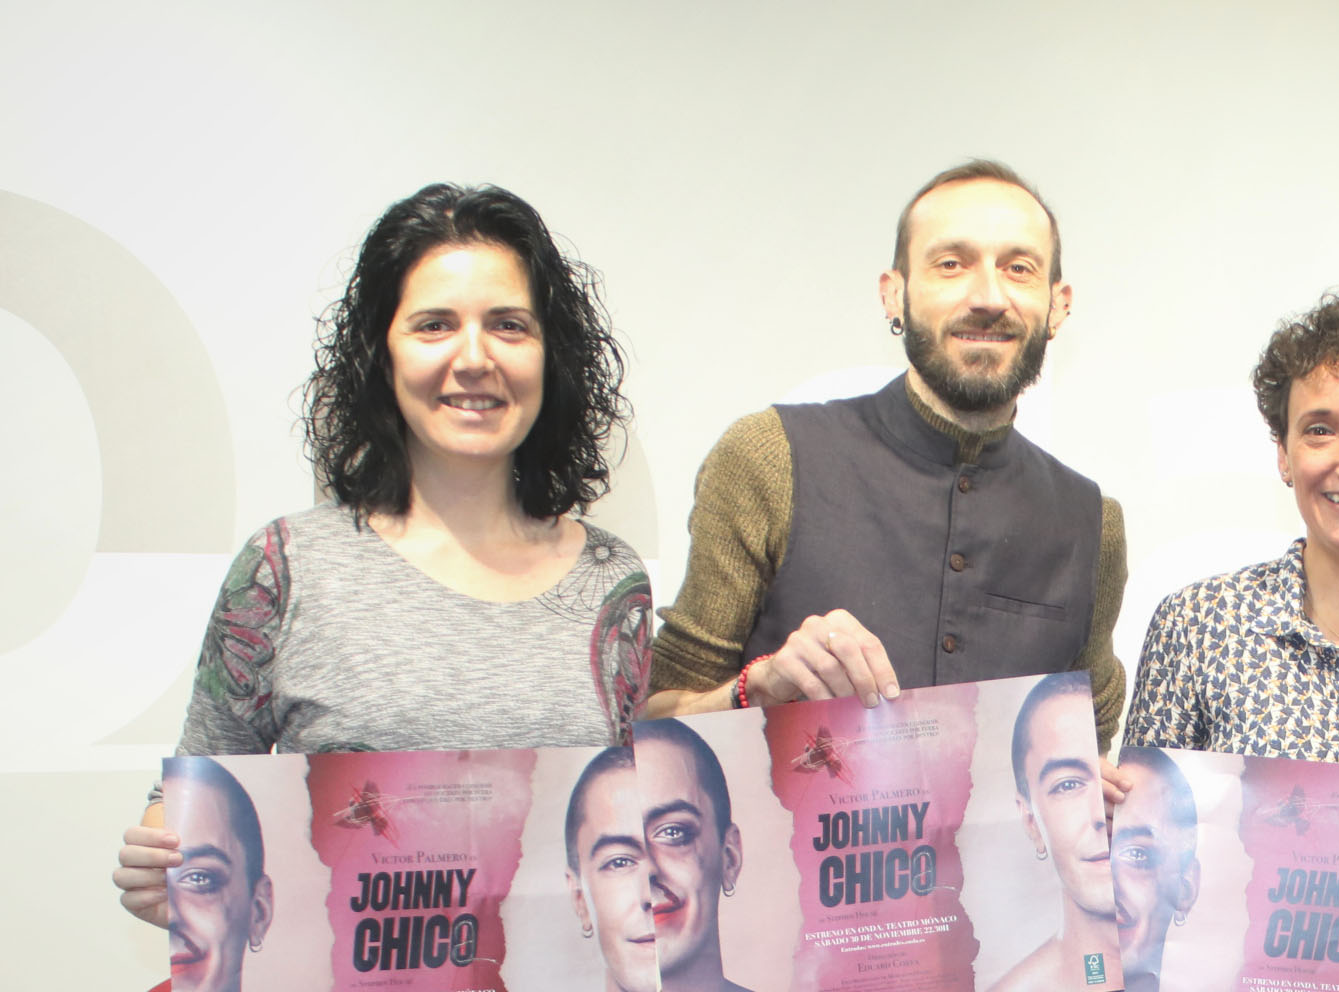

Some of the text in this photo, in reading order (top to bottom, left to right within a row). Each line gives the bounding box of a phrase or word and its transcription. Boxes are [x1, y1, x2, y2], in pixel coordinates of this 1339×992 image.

[871, 787, 920, 800] PALMERO
[813, 801, 930, 852] JOHNNY
[416, 850, 468, 862] PALMERO
[819, 844, 936, 908] CHICO
[350, 868, 477, 913] JOHNNY
[804, 928, 844, 941] ESTRENO
[844, 926, 856, 935] EN
[884, 918, 919, 930] TEATRO
[920, 914, 958, 925] MÓNACO
[859, 933, 873, 941] DE
[873, 926, 923, 940] NOVIEMBRE
[352, 912, 479, 972] CHICO
[1242, 976, 1280, 986] ESTRENO
[1280, 979, 1292, 987] EN
